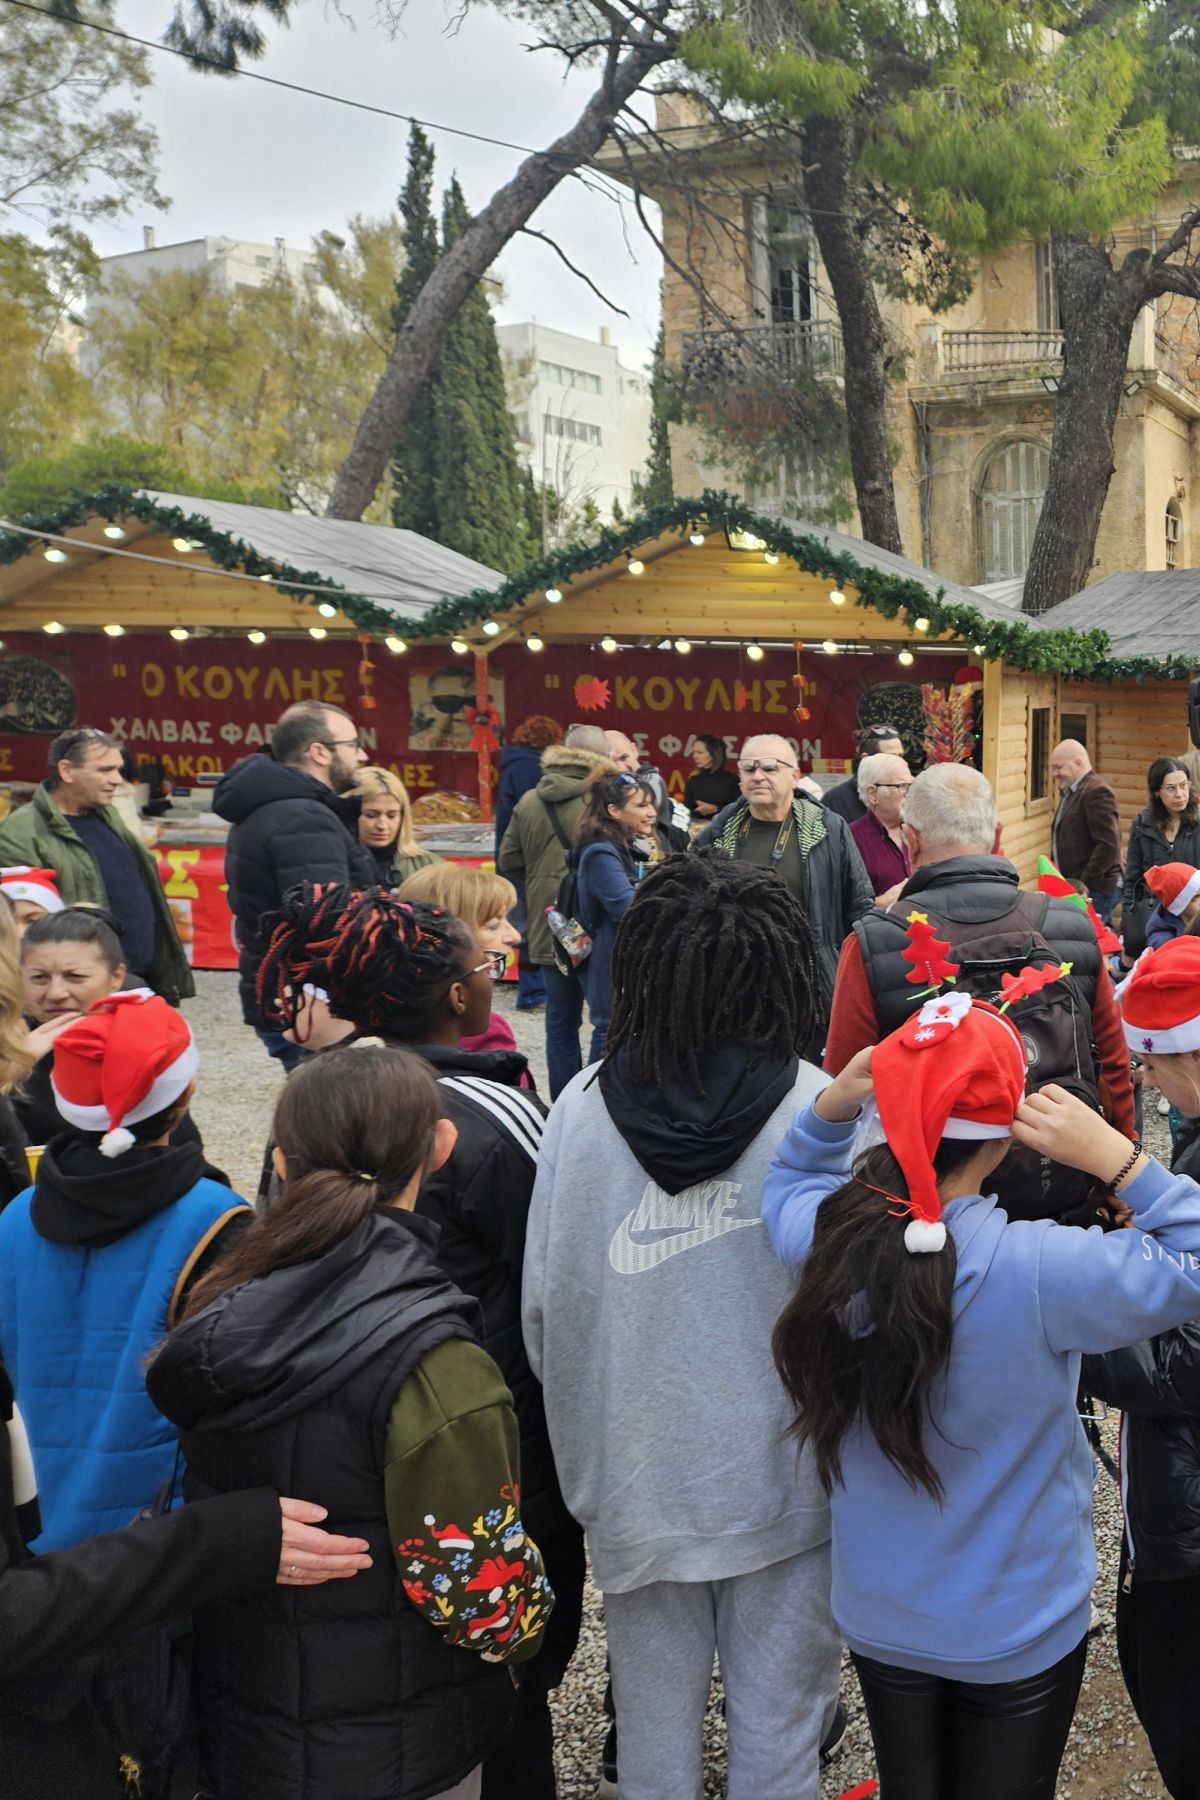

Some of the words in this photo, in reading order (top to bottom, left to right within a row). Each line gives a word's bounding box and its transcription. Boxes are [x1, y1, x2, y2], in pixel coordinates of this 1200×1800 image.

[174, 664, 346, 703] ΚΟΥΛΗΣ
[614, 675, 789, 714] ΚΟΥΛΗΣ
[110, 716, 213, 745] ΧΑΛΒΑΣ
[630, 1180, 743, 1232] NIKE
